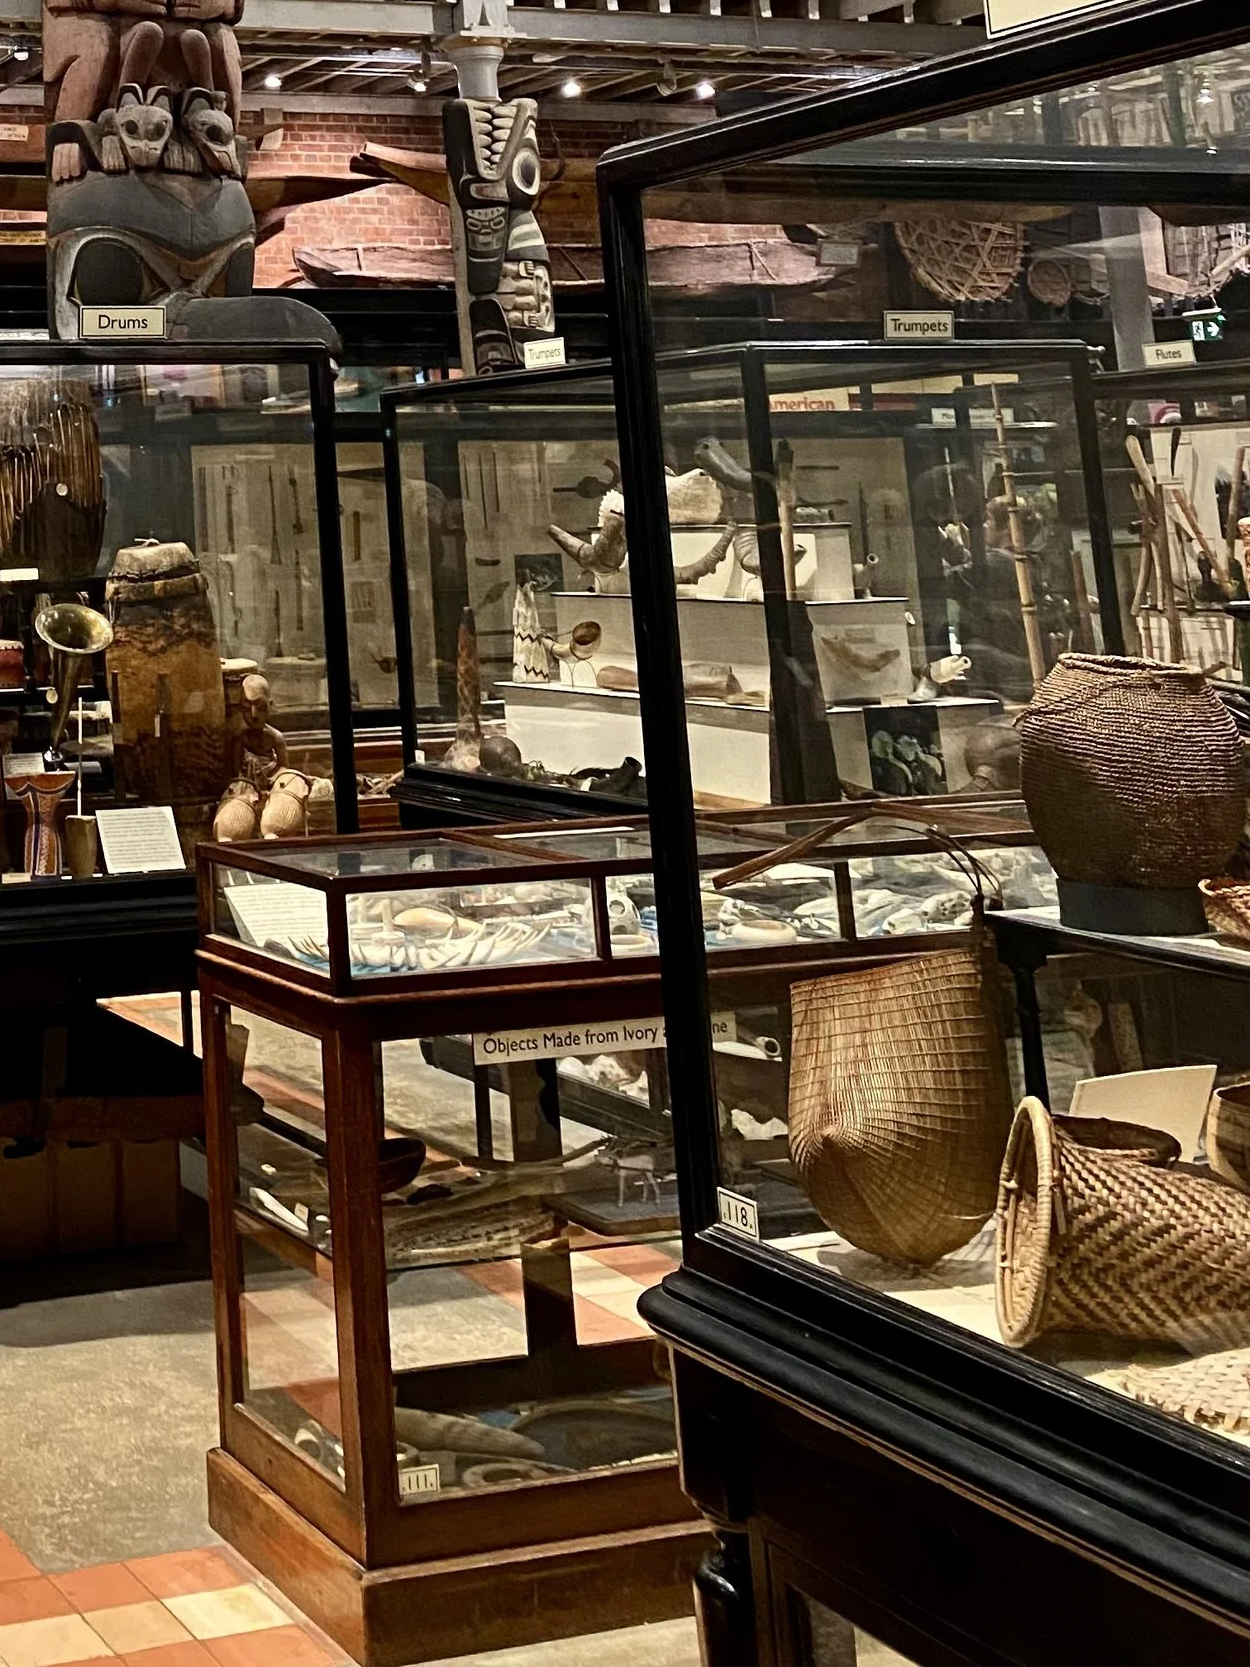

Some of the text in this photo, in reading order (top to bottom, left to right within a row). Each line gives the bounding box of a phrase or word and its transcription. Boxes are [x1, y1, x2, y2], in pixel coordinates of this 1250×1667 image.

[98, 314, 148, 329] Drums
[890, 318, 949, 335] Trumpets
[528, 348, 561, 361] Trumpets
[1155, 348, 1182, 360] Flutes
[769, 396, 836, 412] merican
[483, 1037, 538, 1056] Objects
[543, 1031, 581, 1049] Made
[584, 1028, 619, 1046] from
[623, 1025, 658, 1043] Ivory
